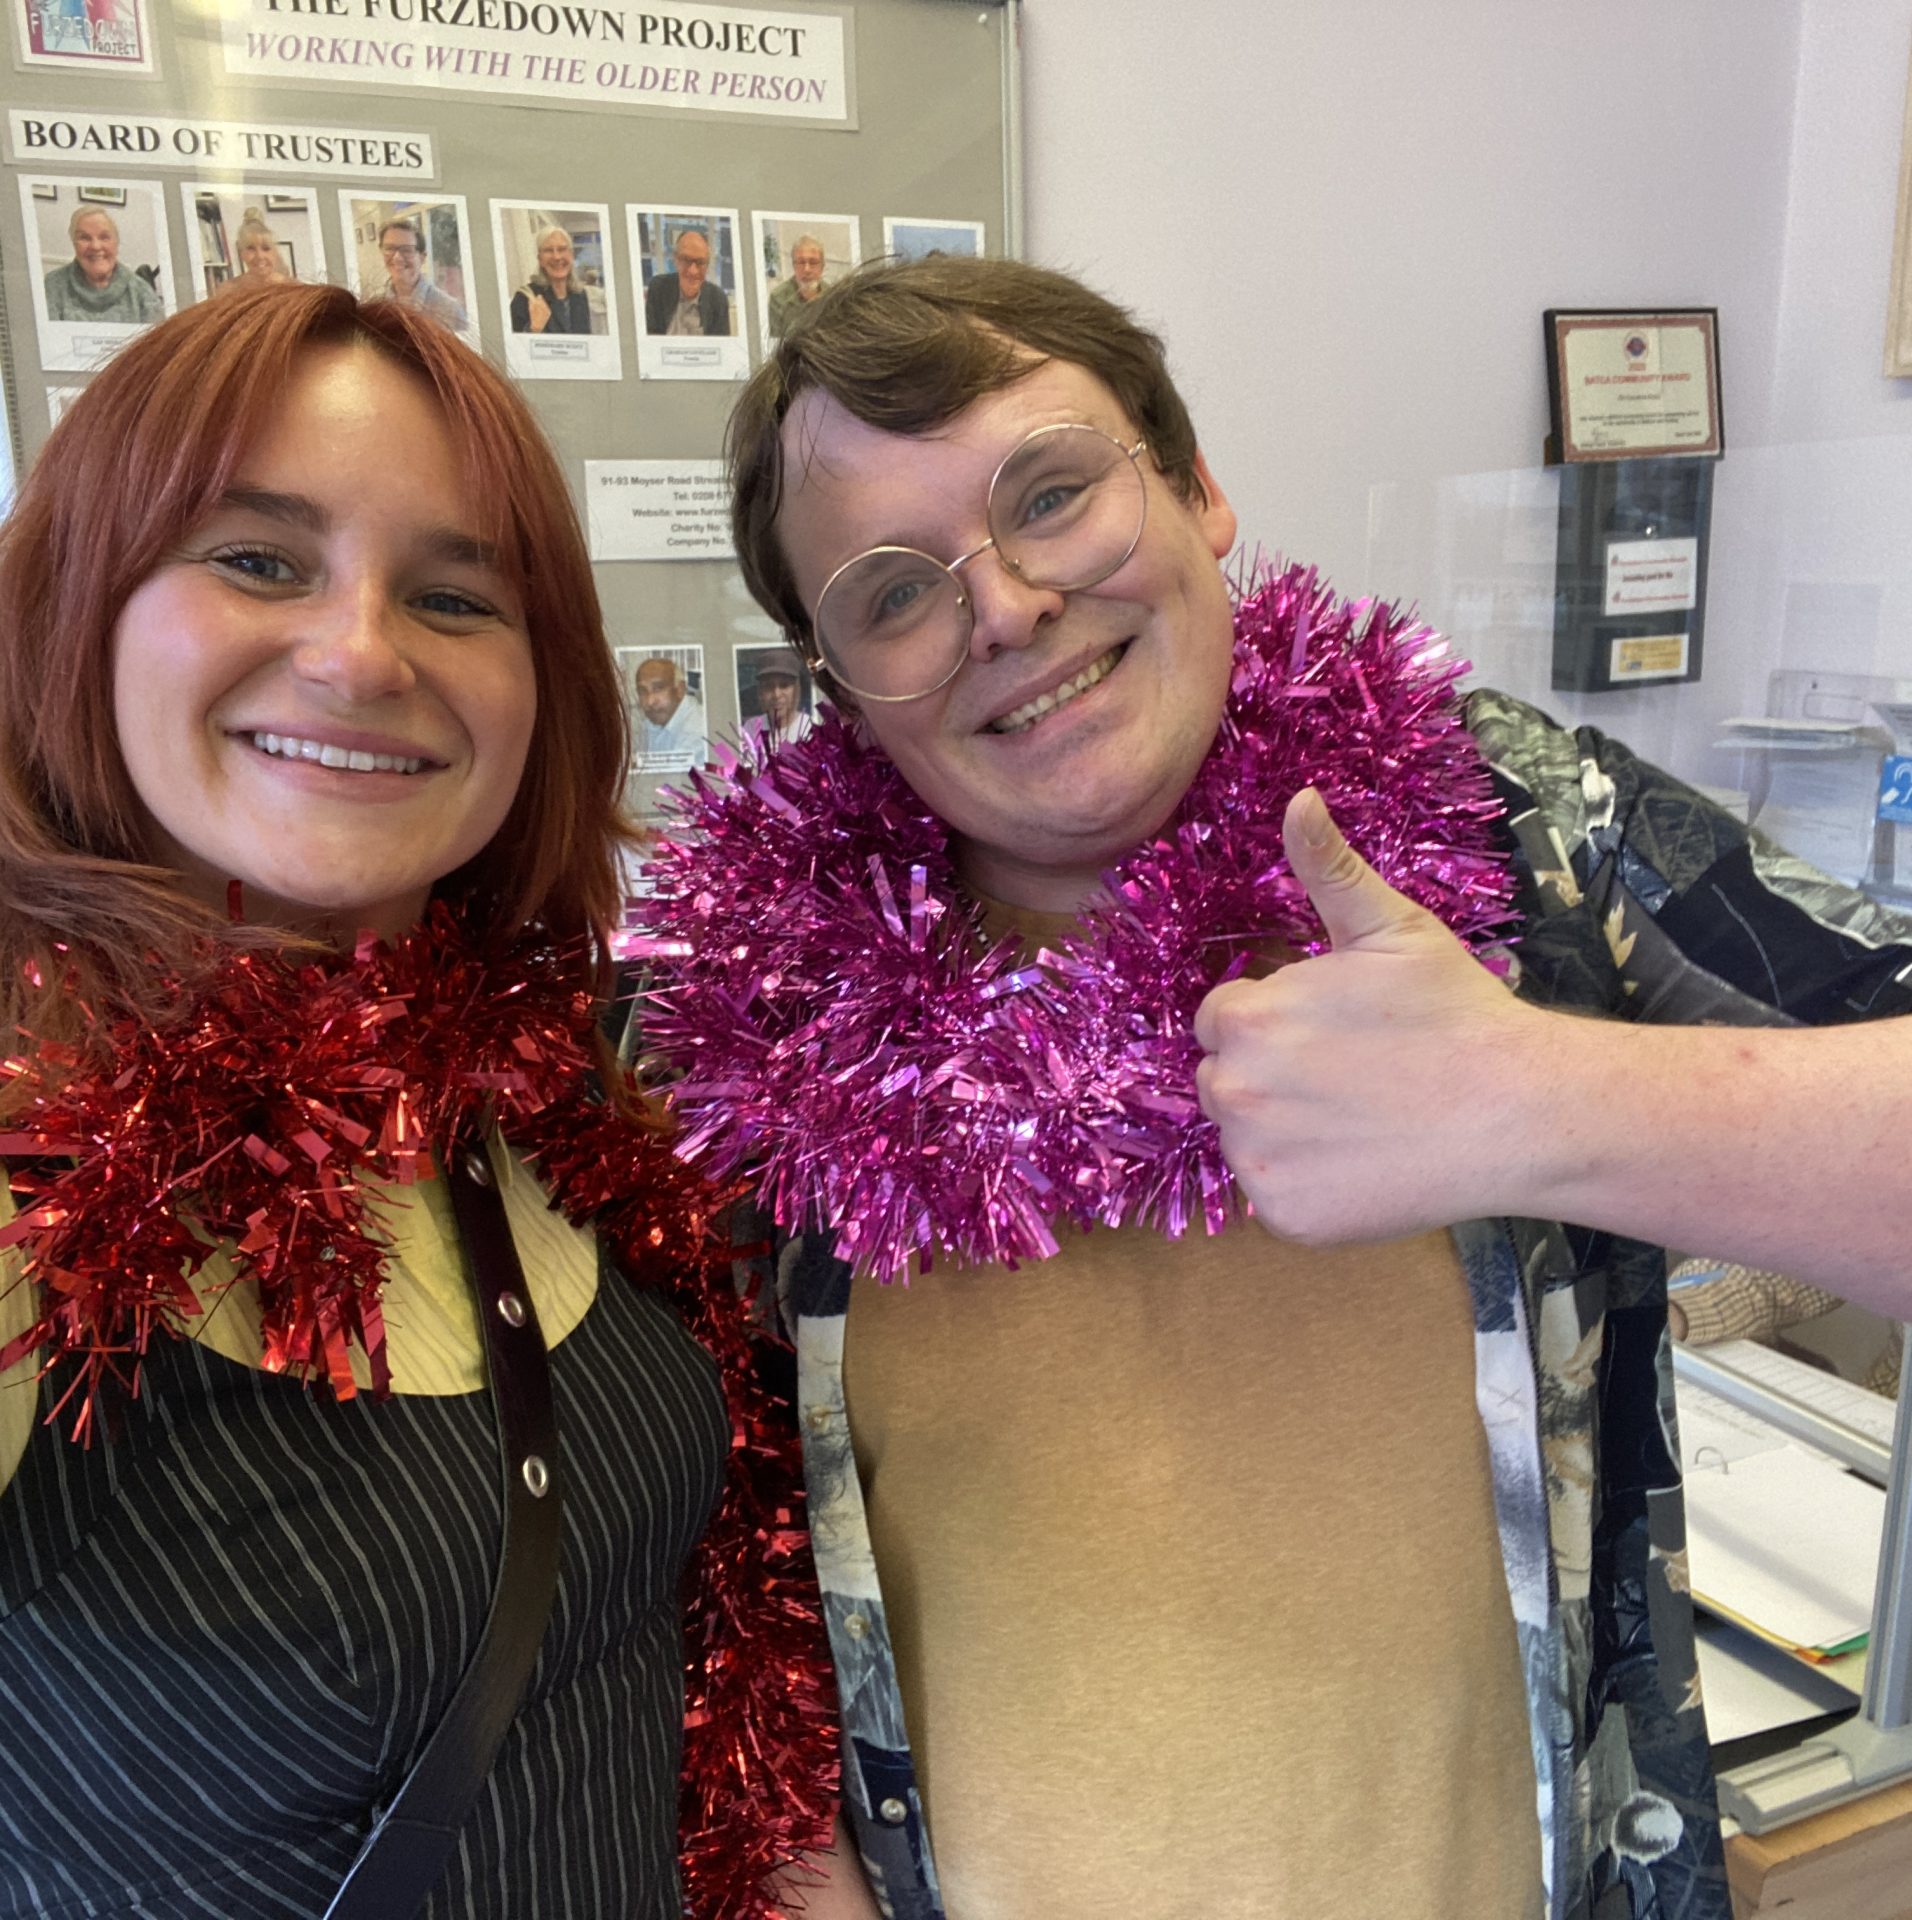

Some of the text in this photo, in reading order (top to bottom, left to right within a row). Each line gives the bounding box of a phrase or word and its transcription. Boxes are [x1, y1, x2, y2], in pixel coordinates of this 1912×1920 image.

[364, 0, 807, 58] FURZEDOWN PROJECT
[92, 40, 137, 56] PROJECT
[247, 32, 828, 104] WORKING WITH THE OLDER PERSON
[21, 119, 424, 169] BOARD OF TRUSTEES
[601, 476, 629, 486] 91-93
[630, 476, 665, 487] Moyser
[667, 475, 692, 485] Road
[671, 522, 704, 534] Charity
[667, 537, 710, 548] Company
